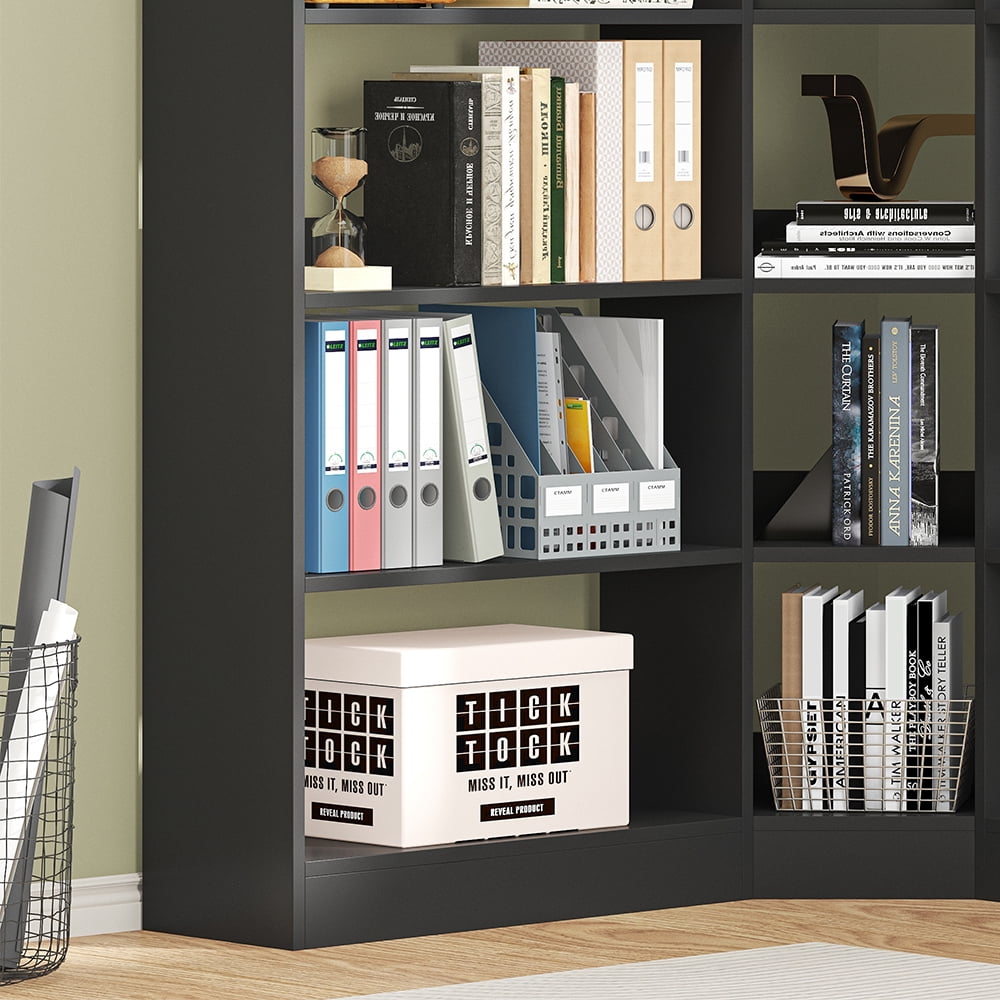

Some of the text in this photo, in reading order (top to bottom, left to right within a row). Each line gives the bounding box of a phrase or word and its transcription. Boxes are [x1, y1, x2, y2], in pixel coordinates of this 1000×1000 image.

[841, 342, 853, 411] THE CURTAIN
[888, 395, 901, 537] ANNA KARENINA
[843, 473, 851, 541] PATRICK ORD
[937, 636, 946, 673] TELLER
[465, 692, 572, 726] TICK
[937, 678, 946, 714] STORY
[465, 732, 572, 766] TOCK
[807, 700, 817, 786] GYPSET
[836, 696, 846, 788] AMERICAN
[891, 700, 901, 785] TIM WALKER
[327, 776, 339, 794] IT,
[341, 779, 364, 795] MISS
[367, 781, 384, 797] OUT
[468, 770, 568, 792] MISS IT, MISS OUT
[319, 807, 364, 821] REVEAL PRODUCT
[490, 803, 544, 817] REVEAL PRODUCT
